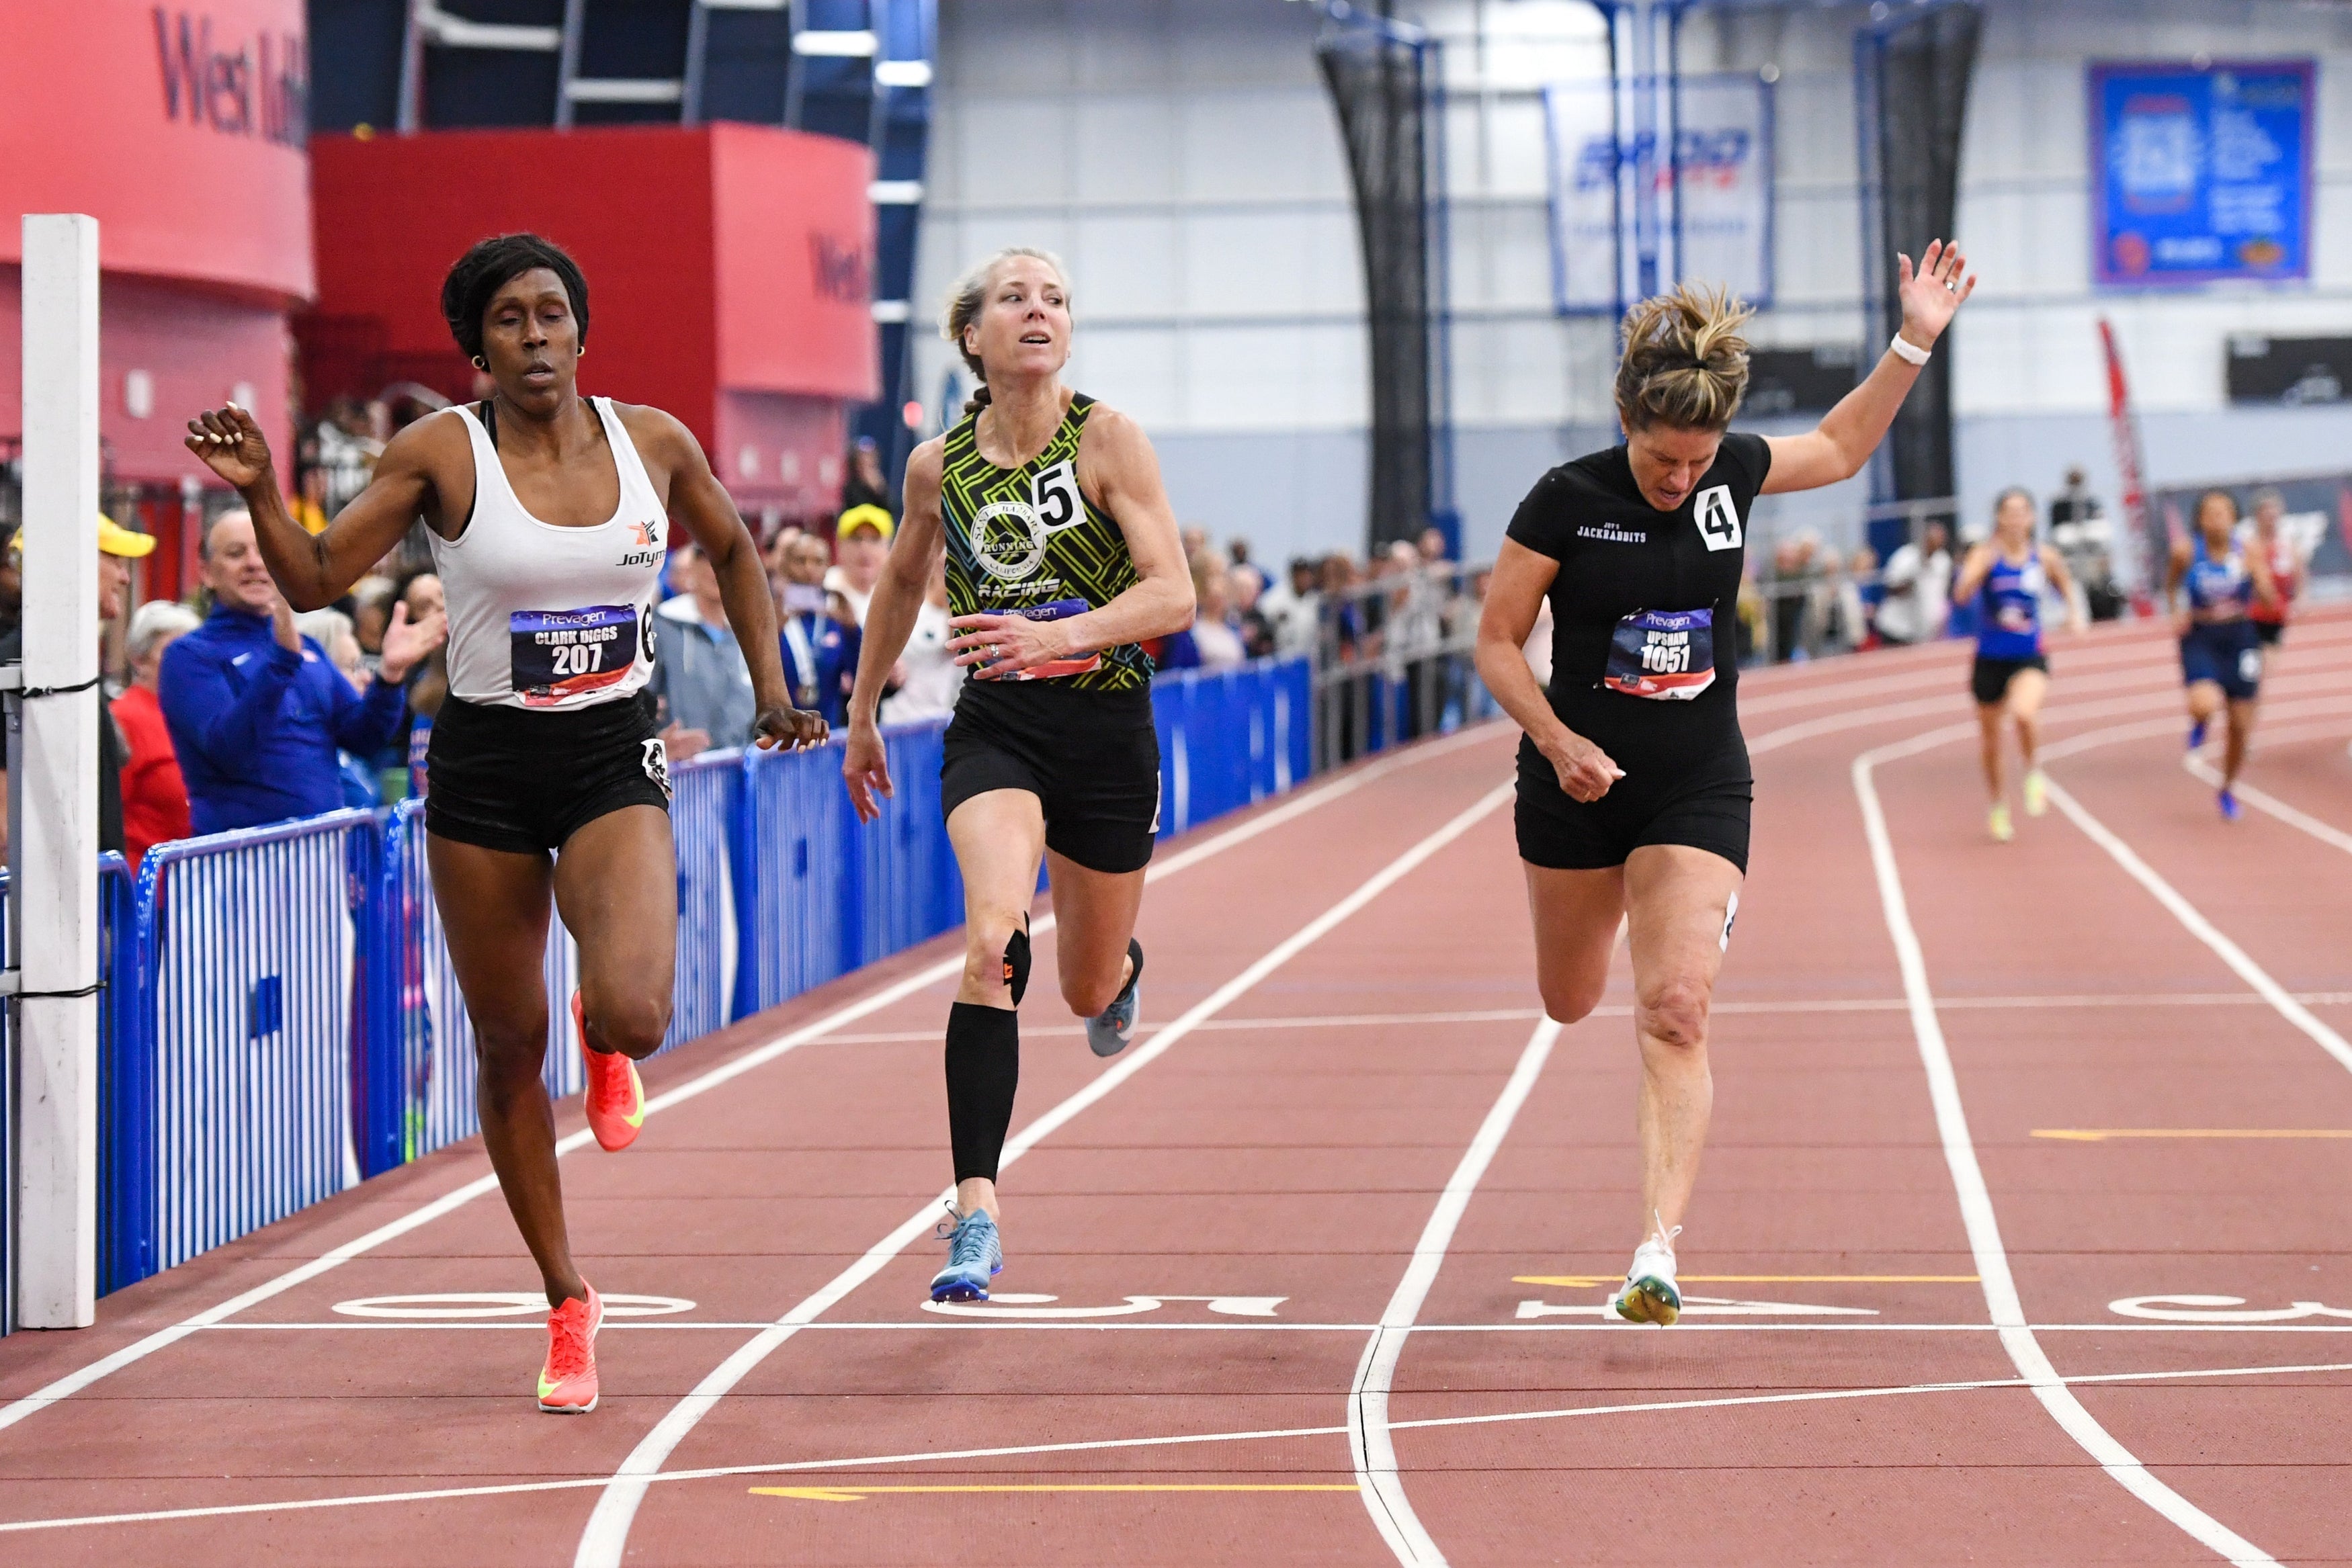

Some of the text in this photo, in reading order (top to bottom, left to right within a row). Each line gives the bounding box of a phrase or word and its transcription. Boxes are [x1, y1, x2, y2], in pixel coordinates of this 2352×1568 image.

[1038, 468, 1073, 526] 5
[974, 509, 997, 541] SANTA
[1705, 492, 1734, 542] 4
[1577, 526, 1646, 543] JACKRABBITS
[983, 541, 1034, 553] RUNNING
[616, 550, 667, 568] JoTym
[990, 560, 1034, 574] CALIFORNIA
[978, 578, 1060, 597] RACING
[543, 611, 606, 626] Prevagen
[1003, 607, 1057, 619] Prevagen
[1646, 613, 1690, 630] Prevagen
[535, 625, 618, 646] CLARK DIGGS
[1647, 630, 1688, 646] UPSHAW
[552, 643, 602, 675] 207
[1640, 644, 1690, 673] 1051
